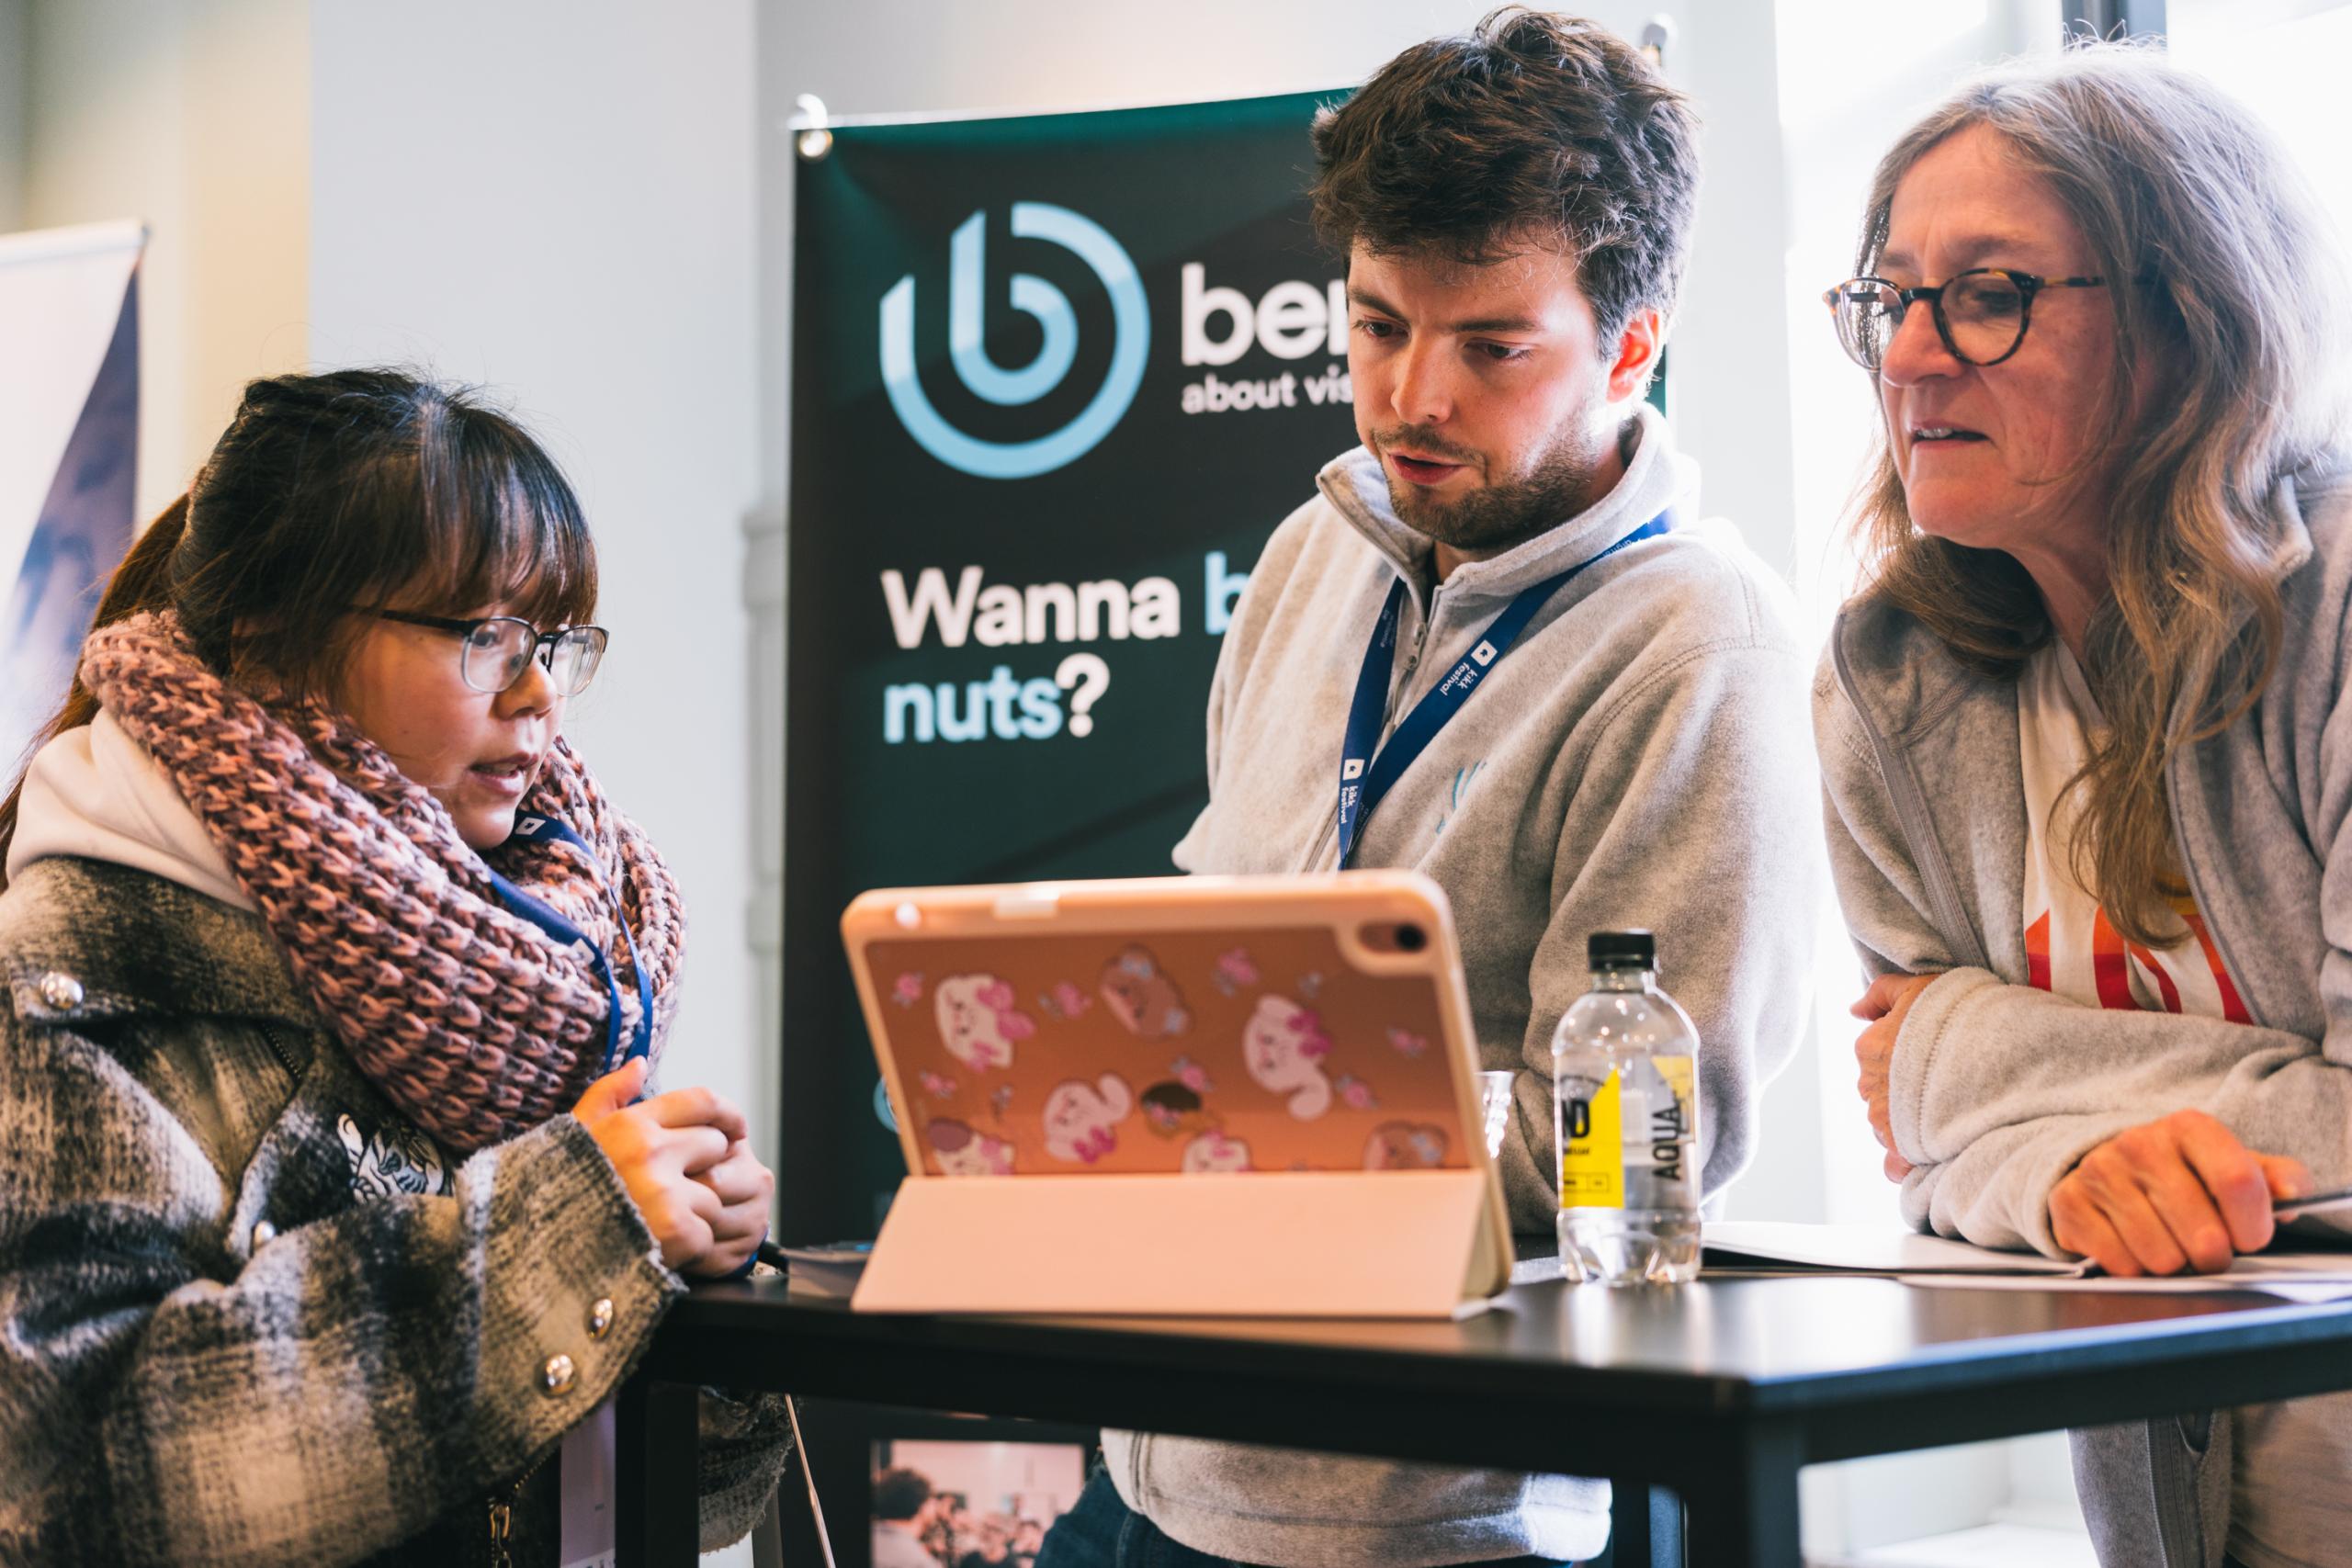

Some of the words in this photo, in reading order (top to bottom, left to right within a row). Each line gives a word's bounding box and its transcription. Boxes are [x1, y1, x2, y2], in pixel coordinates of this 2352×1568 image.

[1181, 372, 1297, 414] about
[880, 566, 1181, 649] Wanna
[884, 652, 1111, 744] nuts?
[1440, 661, 1470, 696] festival
[1457, 668, 1478, 690] kikk
[1340, 786, 1350, 825] festival
[1348, 784, 1359, 807] kikk
